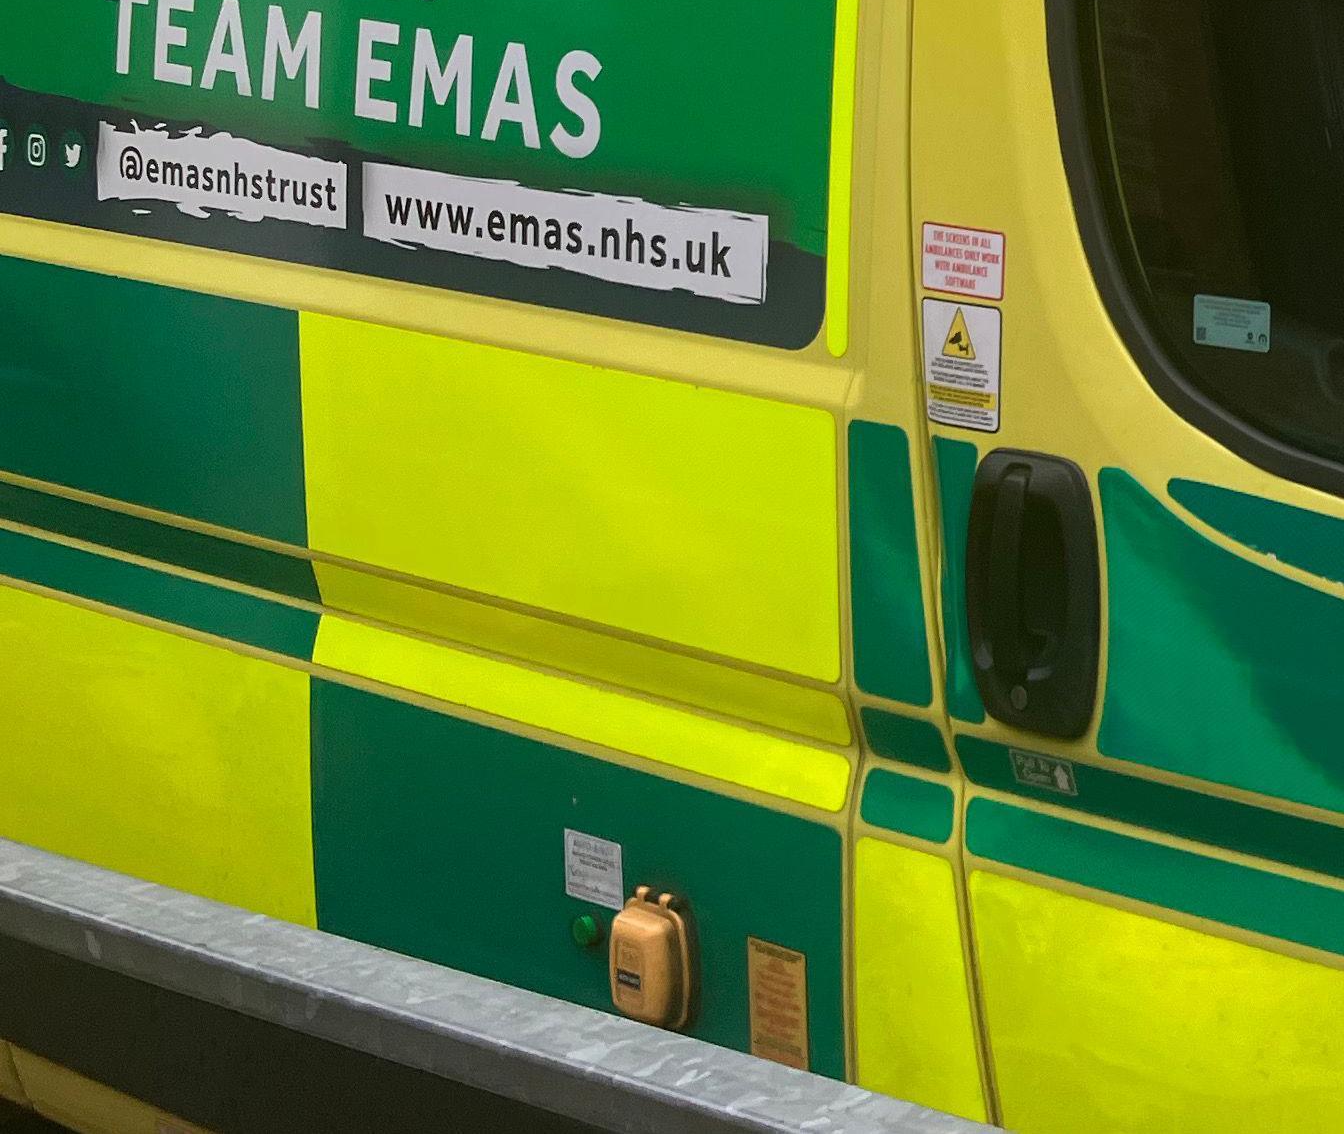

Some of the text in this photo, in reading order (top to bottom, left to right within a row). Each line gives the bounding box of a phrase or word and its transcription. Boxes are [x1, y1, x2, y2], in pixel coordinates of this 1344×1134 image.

[353, 18, 603, 159] EMAS
[118, 145, 733, 279] @emasnhstrust www.emas.nhs.uk
